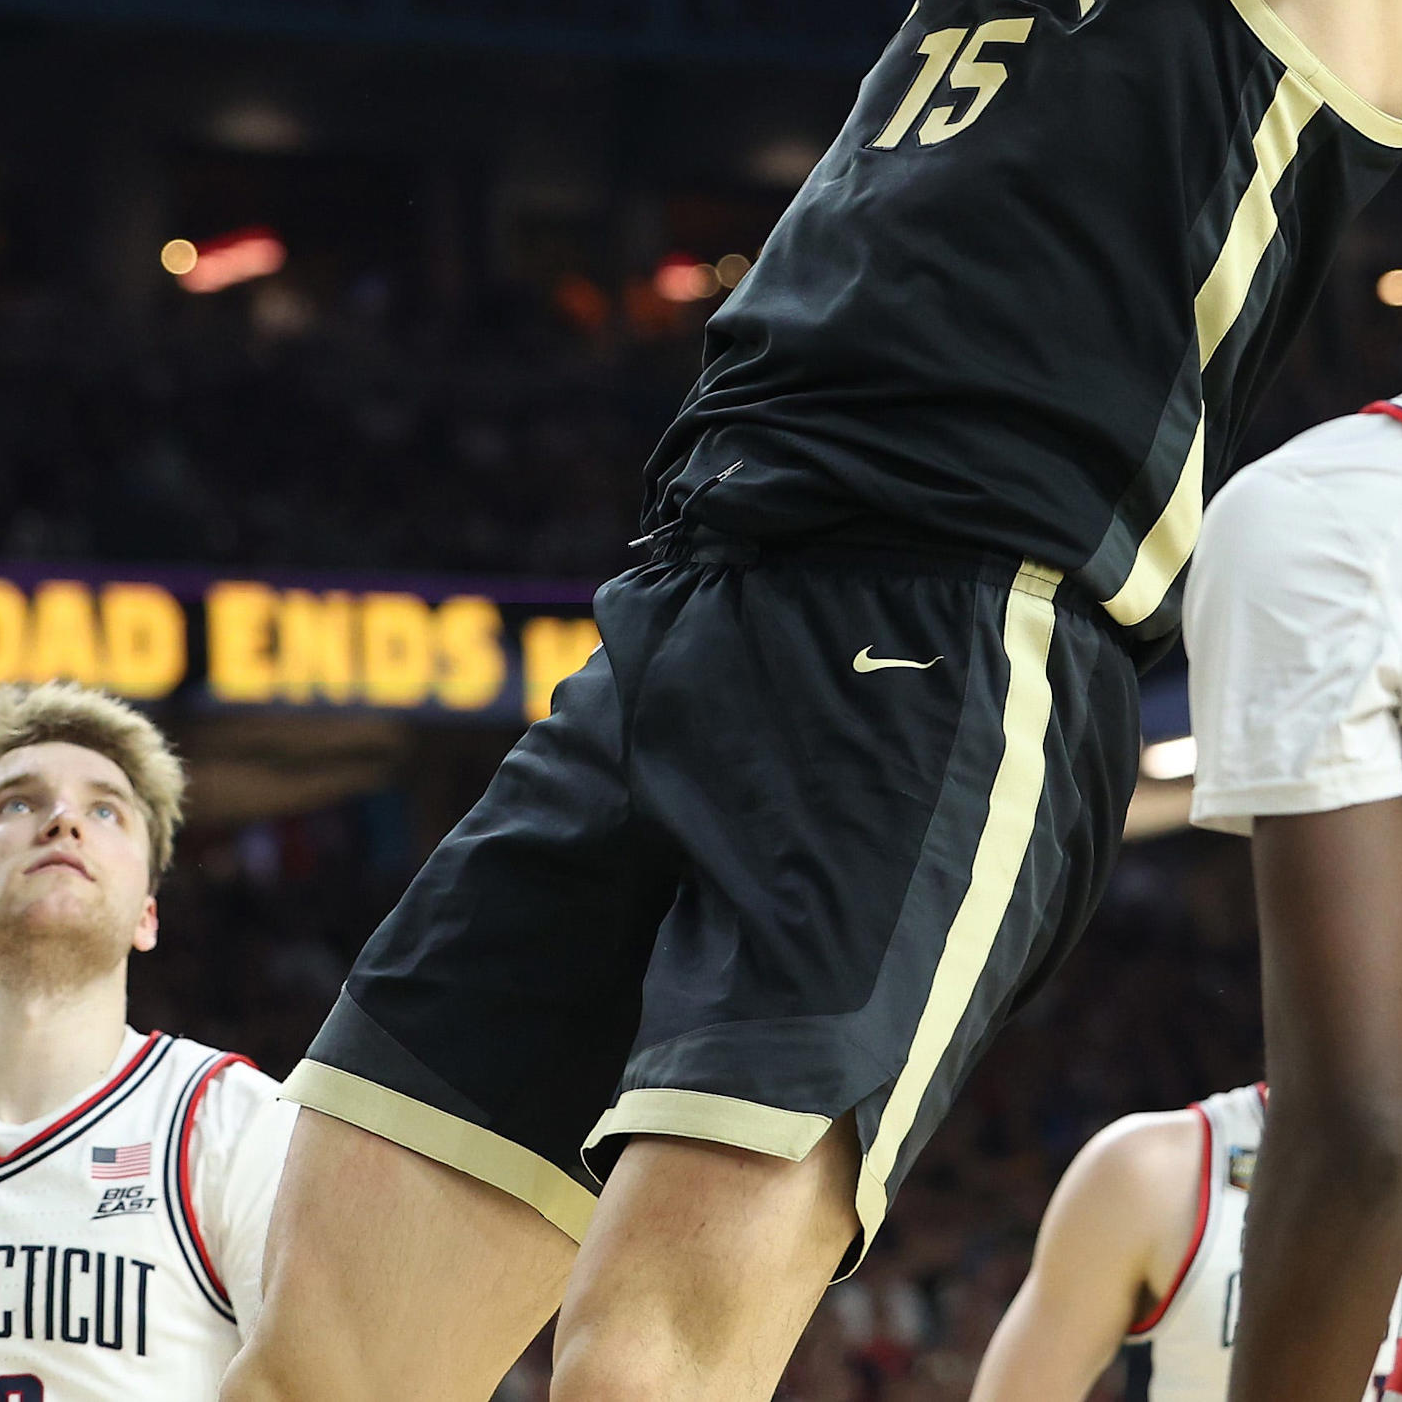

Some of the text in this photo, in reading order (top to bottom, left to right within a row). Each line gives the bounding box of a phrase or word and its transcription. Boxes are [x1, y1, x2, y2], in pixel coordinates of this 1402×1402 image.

[870, 16, 1035, 148] 15
[206, 580, 506, 712] ENDS
[96, 1198, 159, 1214] EAST
[102, 1184, 145, 1200] BIG
